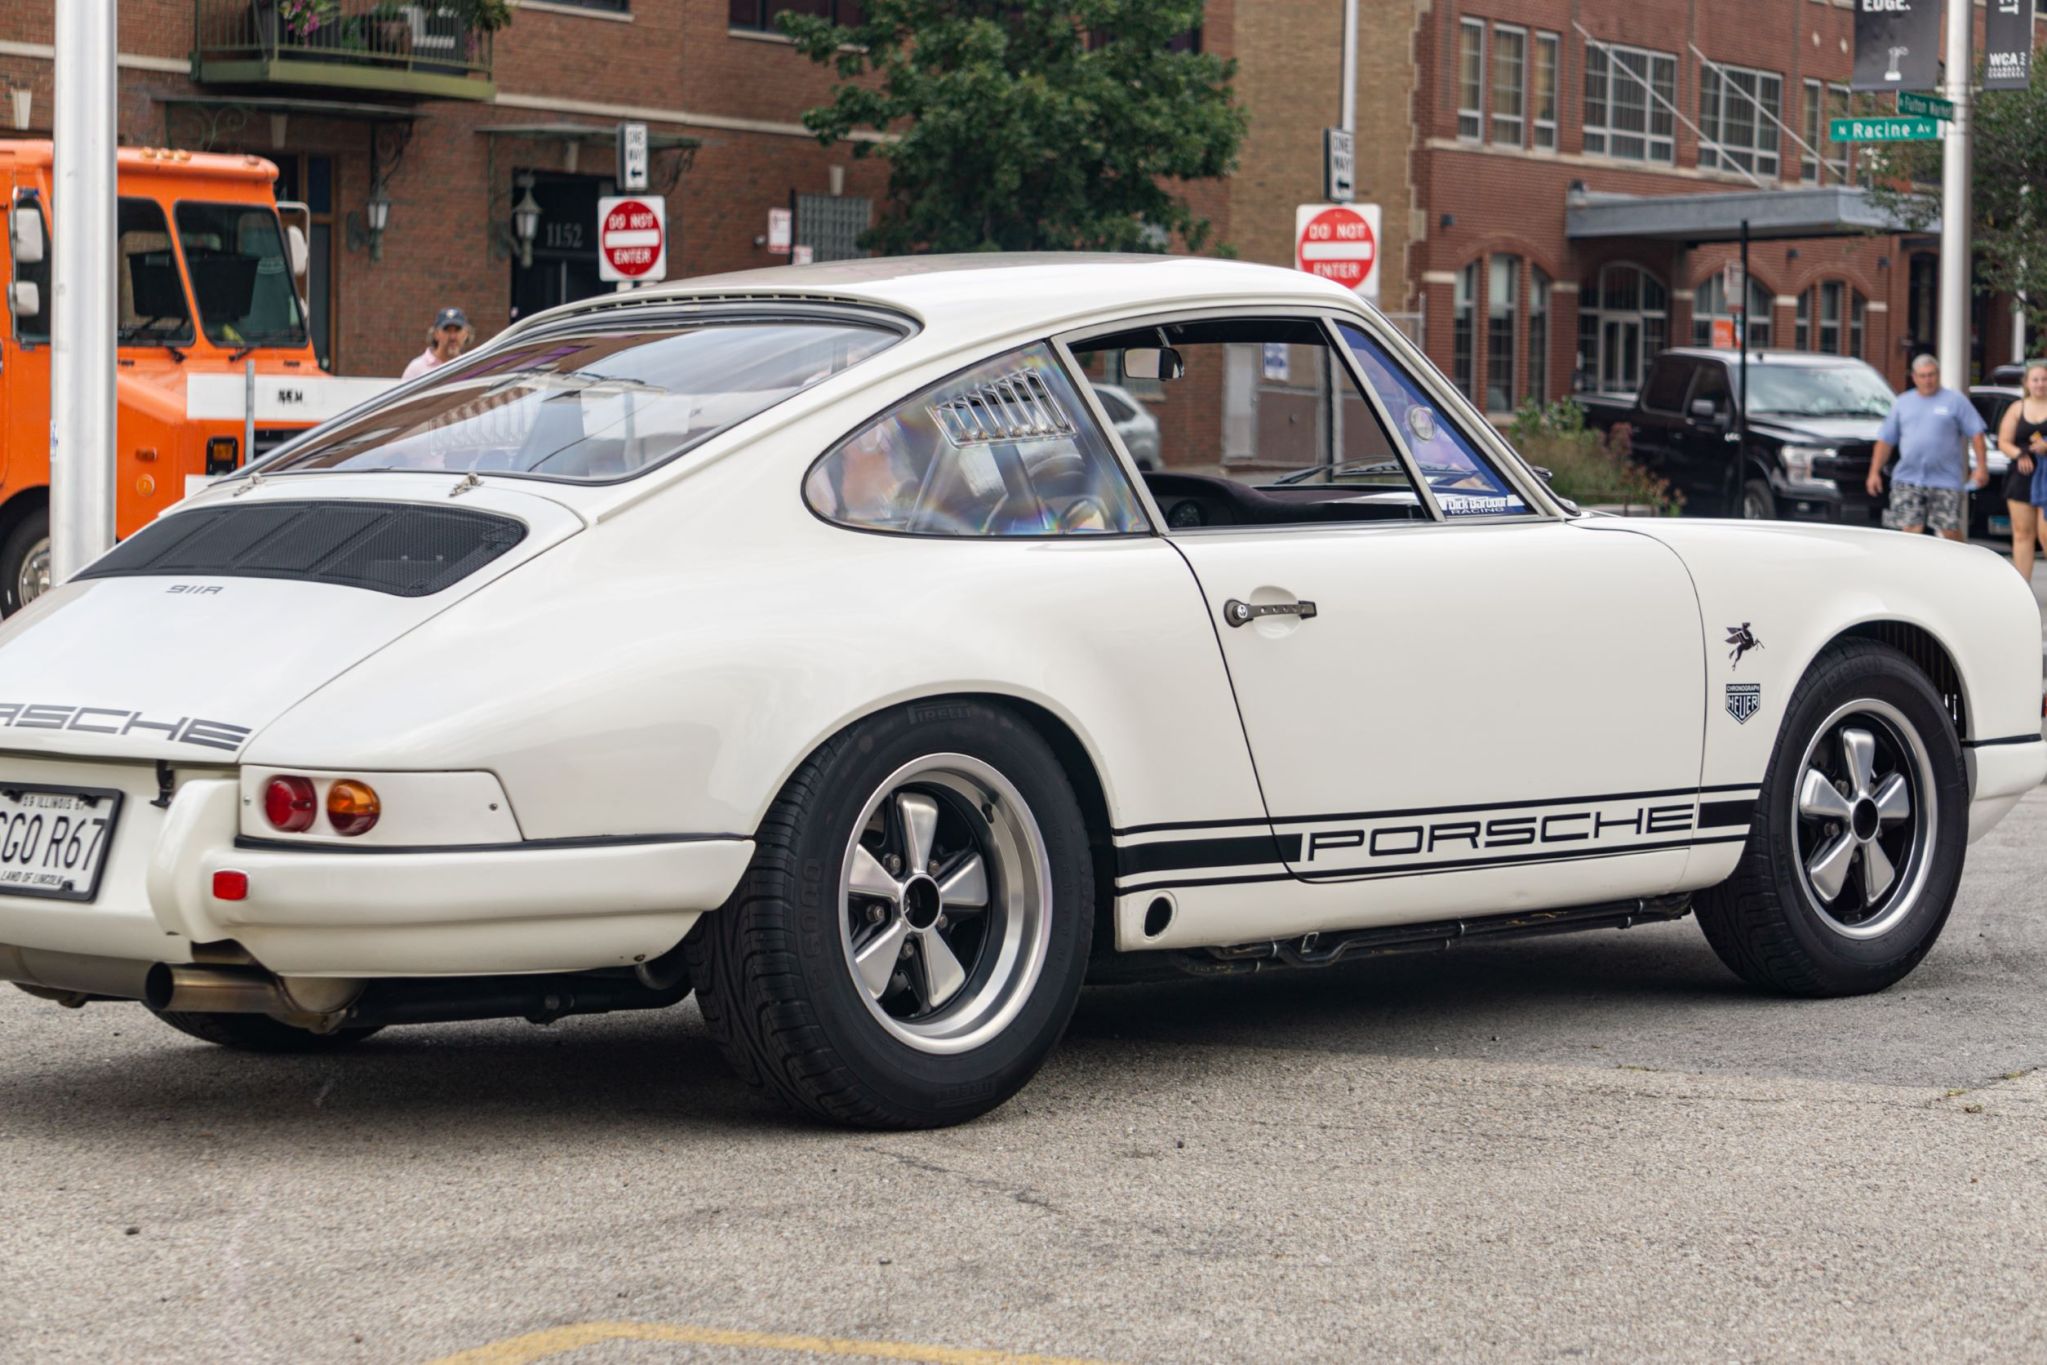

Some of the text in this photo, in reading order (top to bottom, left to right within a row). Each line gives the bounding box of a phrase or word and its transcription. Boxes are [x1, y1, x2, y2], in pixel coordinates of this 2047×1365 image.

[1989, 51, 2018, 66] WCA
[1838, 121, 1931, 139] N Racine Av
[1333, 136, 1351, 153] ONE
[1333, 156, 1352, 172] WAY
[608, 213, 654, 229] DO NOT
[547, 222, 583, 248] 1152
[1309, 223, 1366, 239] DO NOT
[614, 248, 651, 265] ENTER
[1313, 262, 1360, 279] ENTER
[165, 585, 224, 595] 911R
[906, 702, 971, 725] PIRELLI
[1728, 695, 1758, 718] HEUER
[37, 796, 72, 810] ILLINOIS
[0, 811, 107, 871] GO R67
[1308, 804, 1695, 862] PORSCHE
